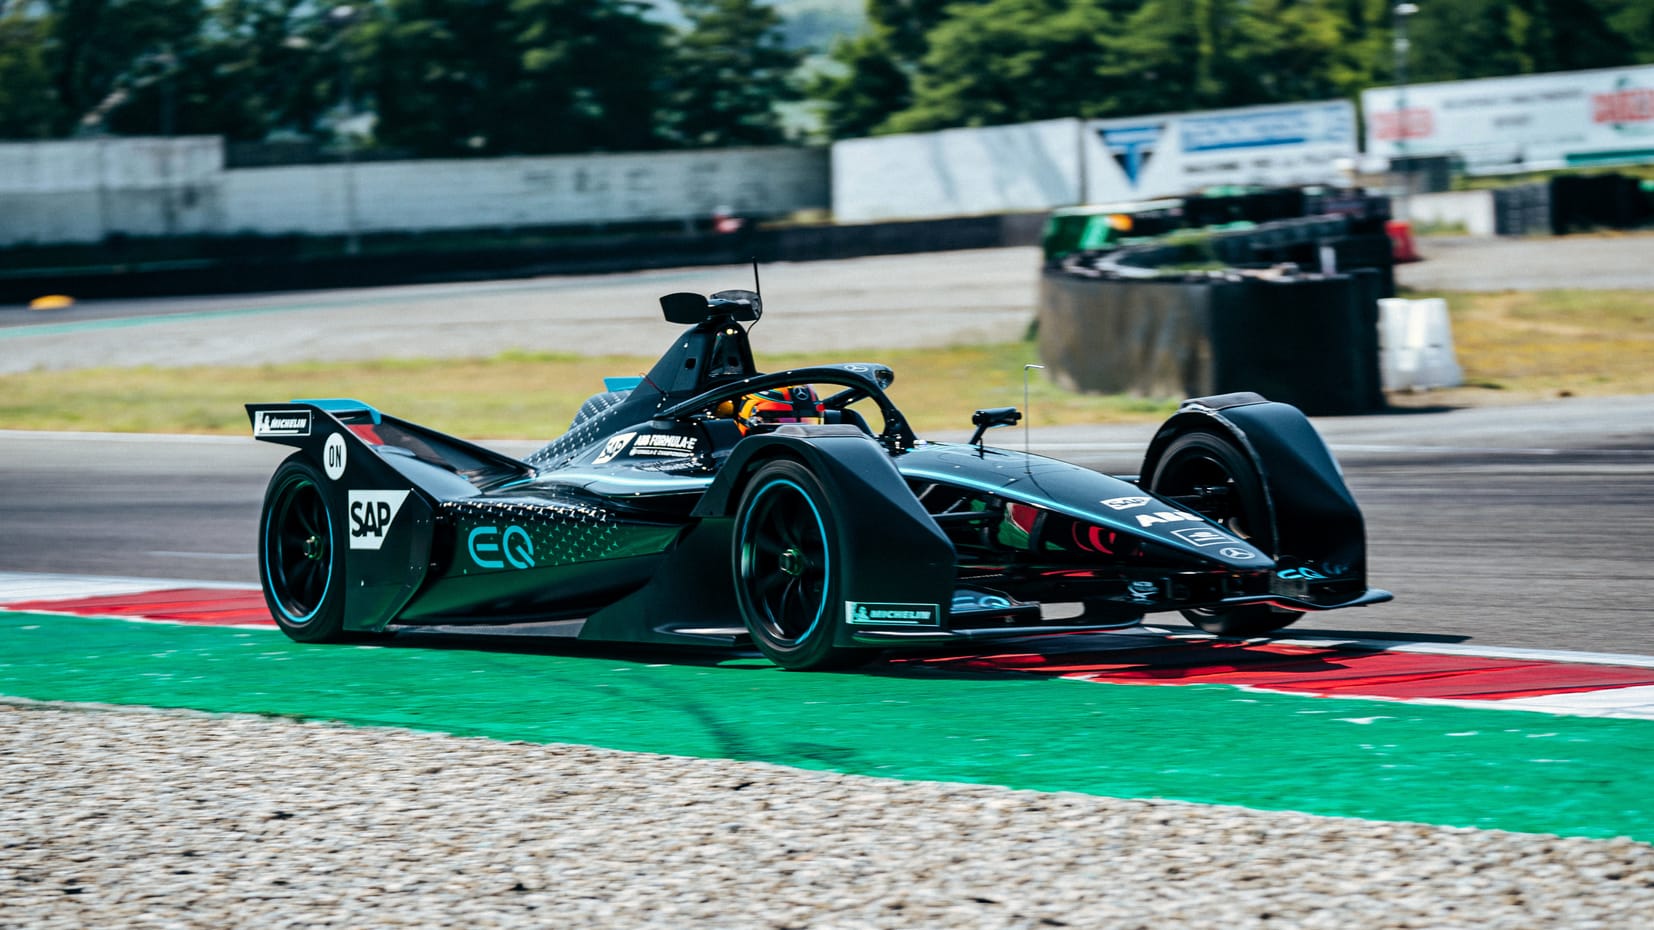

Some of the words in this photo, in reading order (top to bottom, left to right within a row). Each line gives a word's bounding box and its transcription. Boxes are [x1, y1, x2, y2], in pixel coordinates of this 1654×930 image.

[269, 417, 307, 430] MICHELIN
[329, 444, 342, 469] ON
[599, 438, 625, 460] SAP
[1107, 497, 1146, 508] SAP
[350, 500, 391, 538] SAP
[467, 524, 536, 570] EQ
[869, 610, 931, 620] MICHELIN
